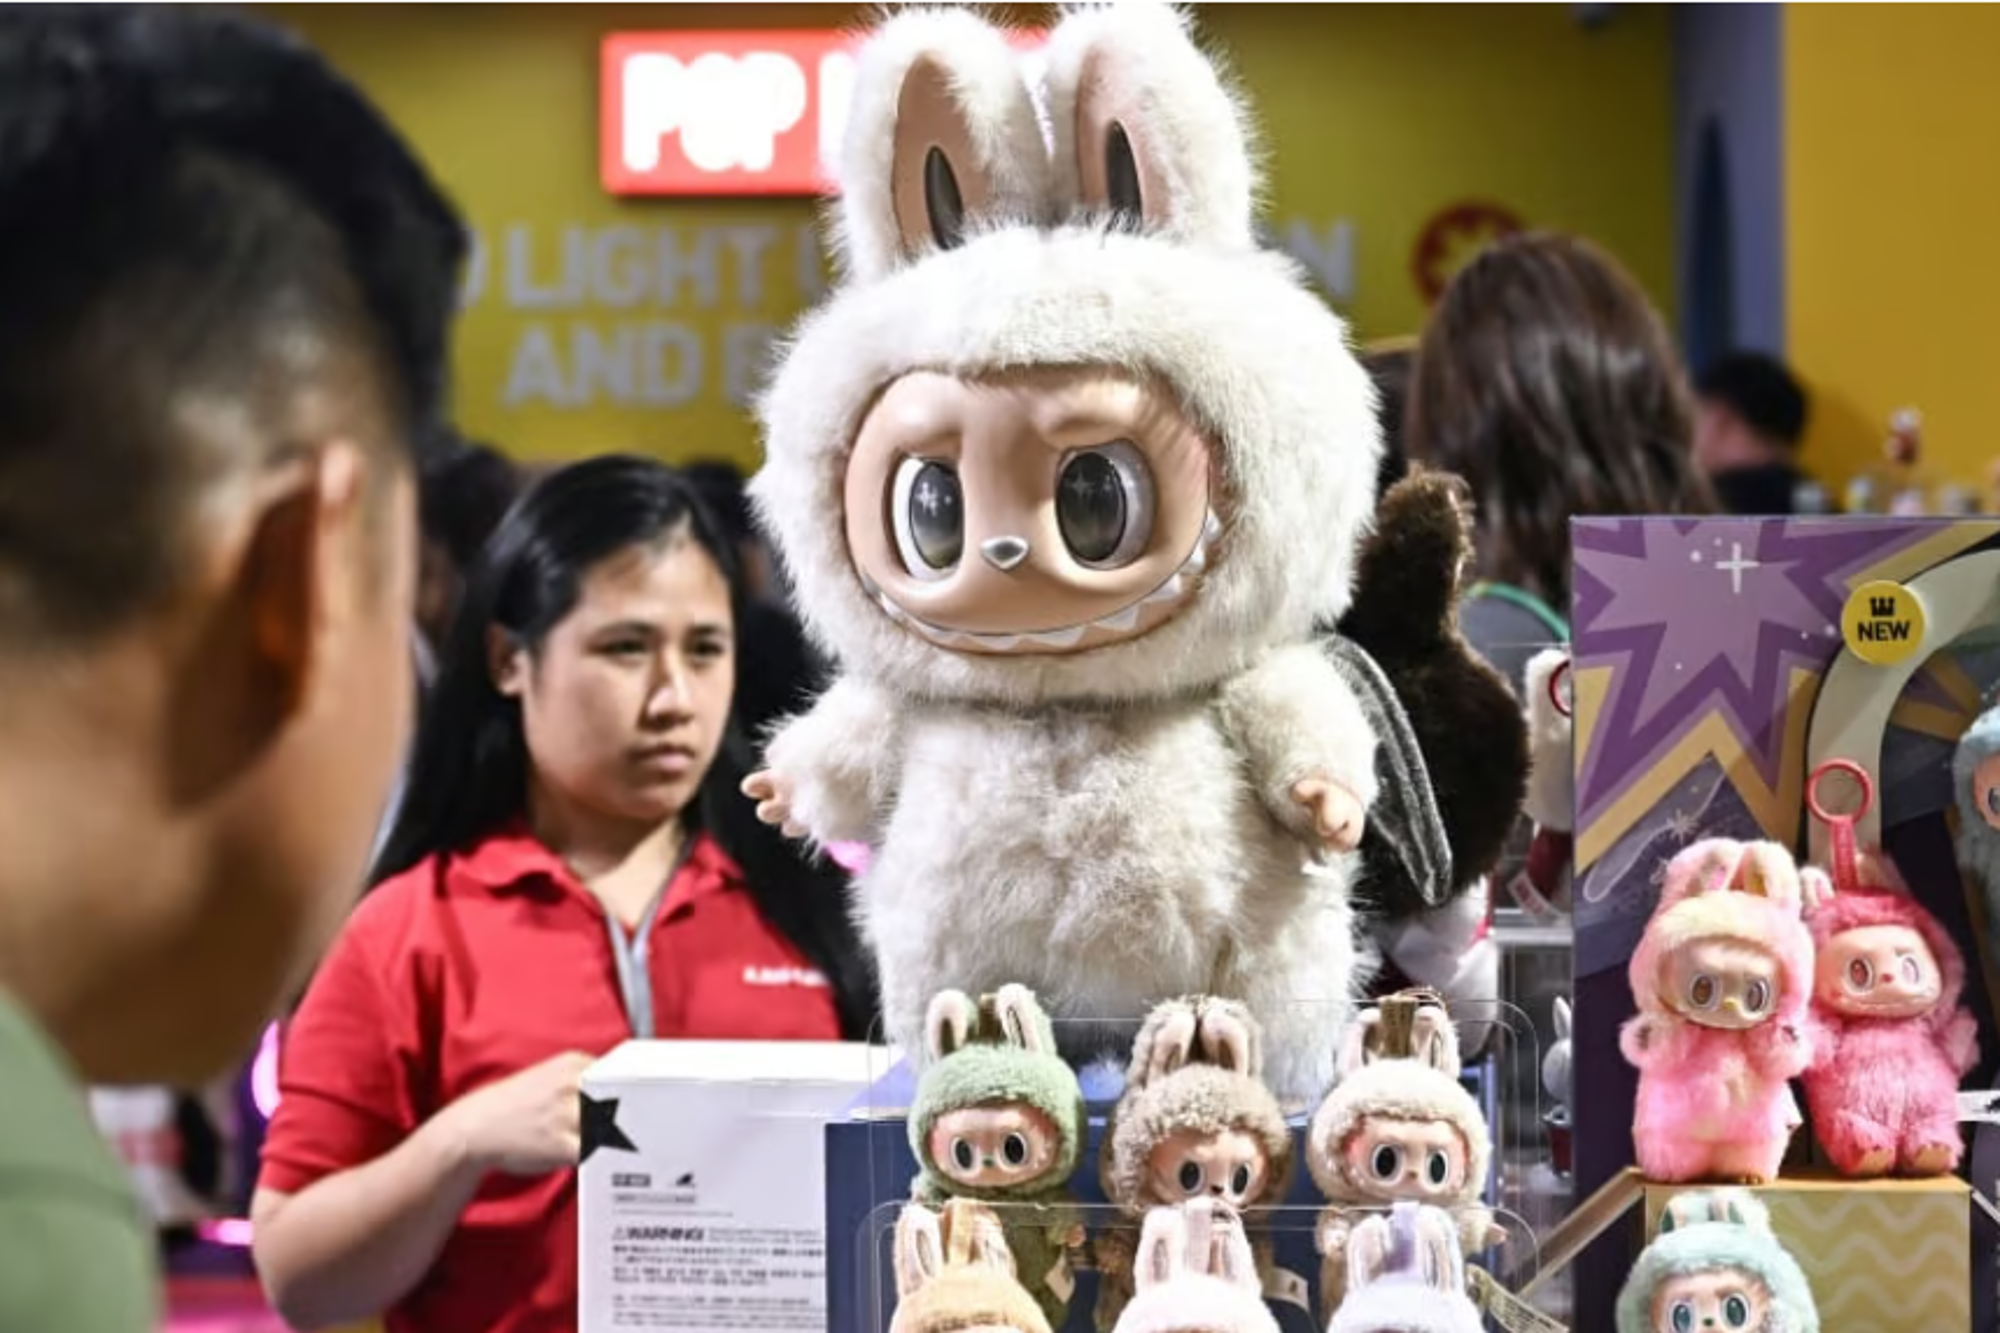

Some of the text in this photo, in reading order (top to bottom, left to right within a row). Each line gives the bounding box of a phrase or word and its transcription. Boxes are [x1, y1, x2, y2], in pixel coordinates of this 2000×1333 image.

[621, 50, 807, 173] POP
[506, 226, 778, 310] LIGHT
[502, 321, 709, 408] AND
[1857, 620, 1911, 642] NEW
